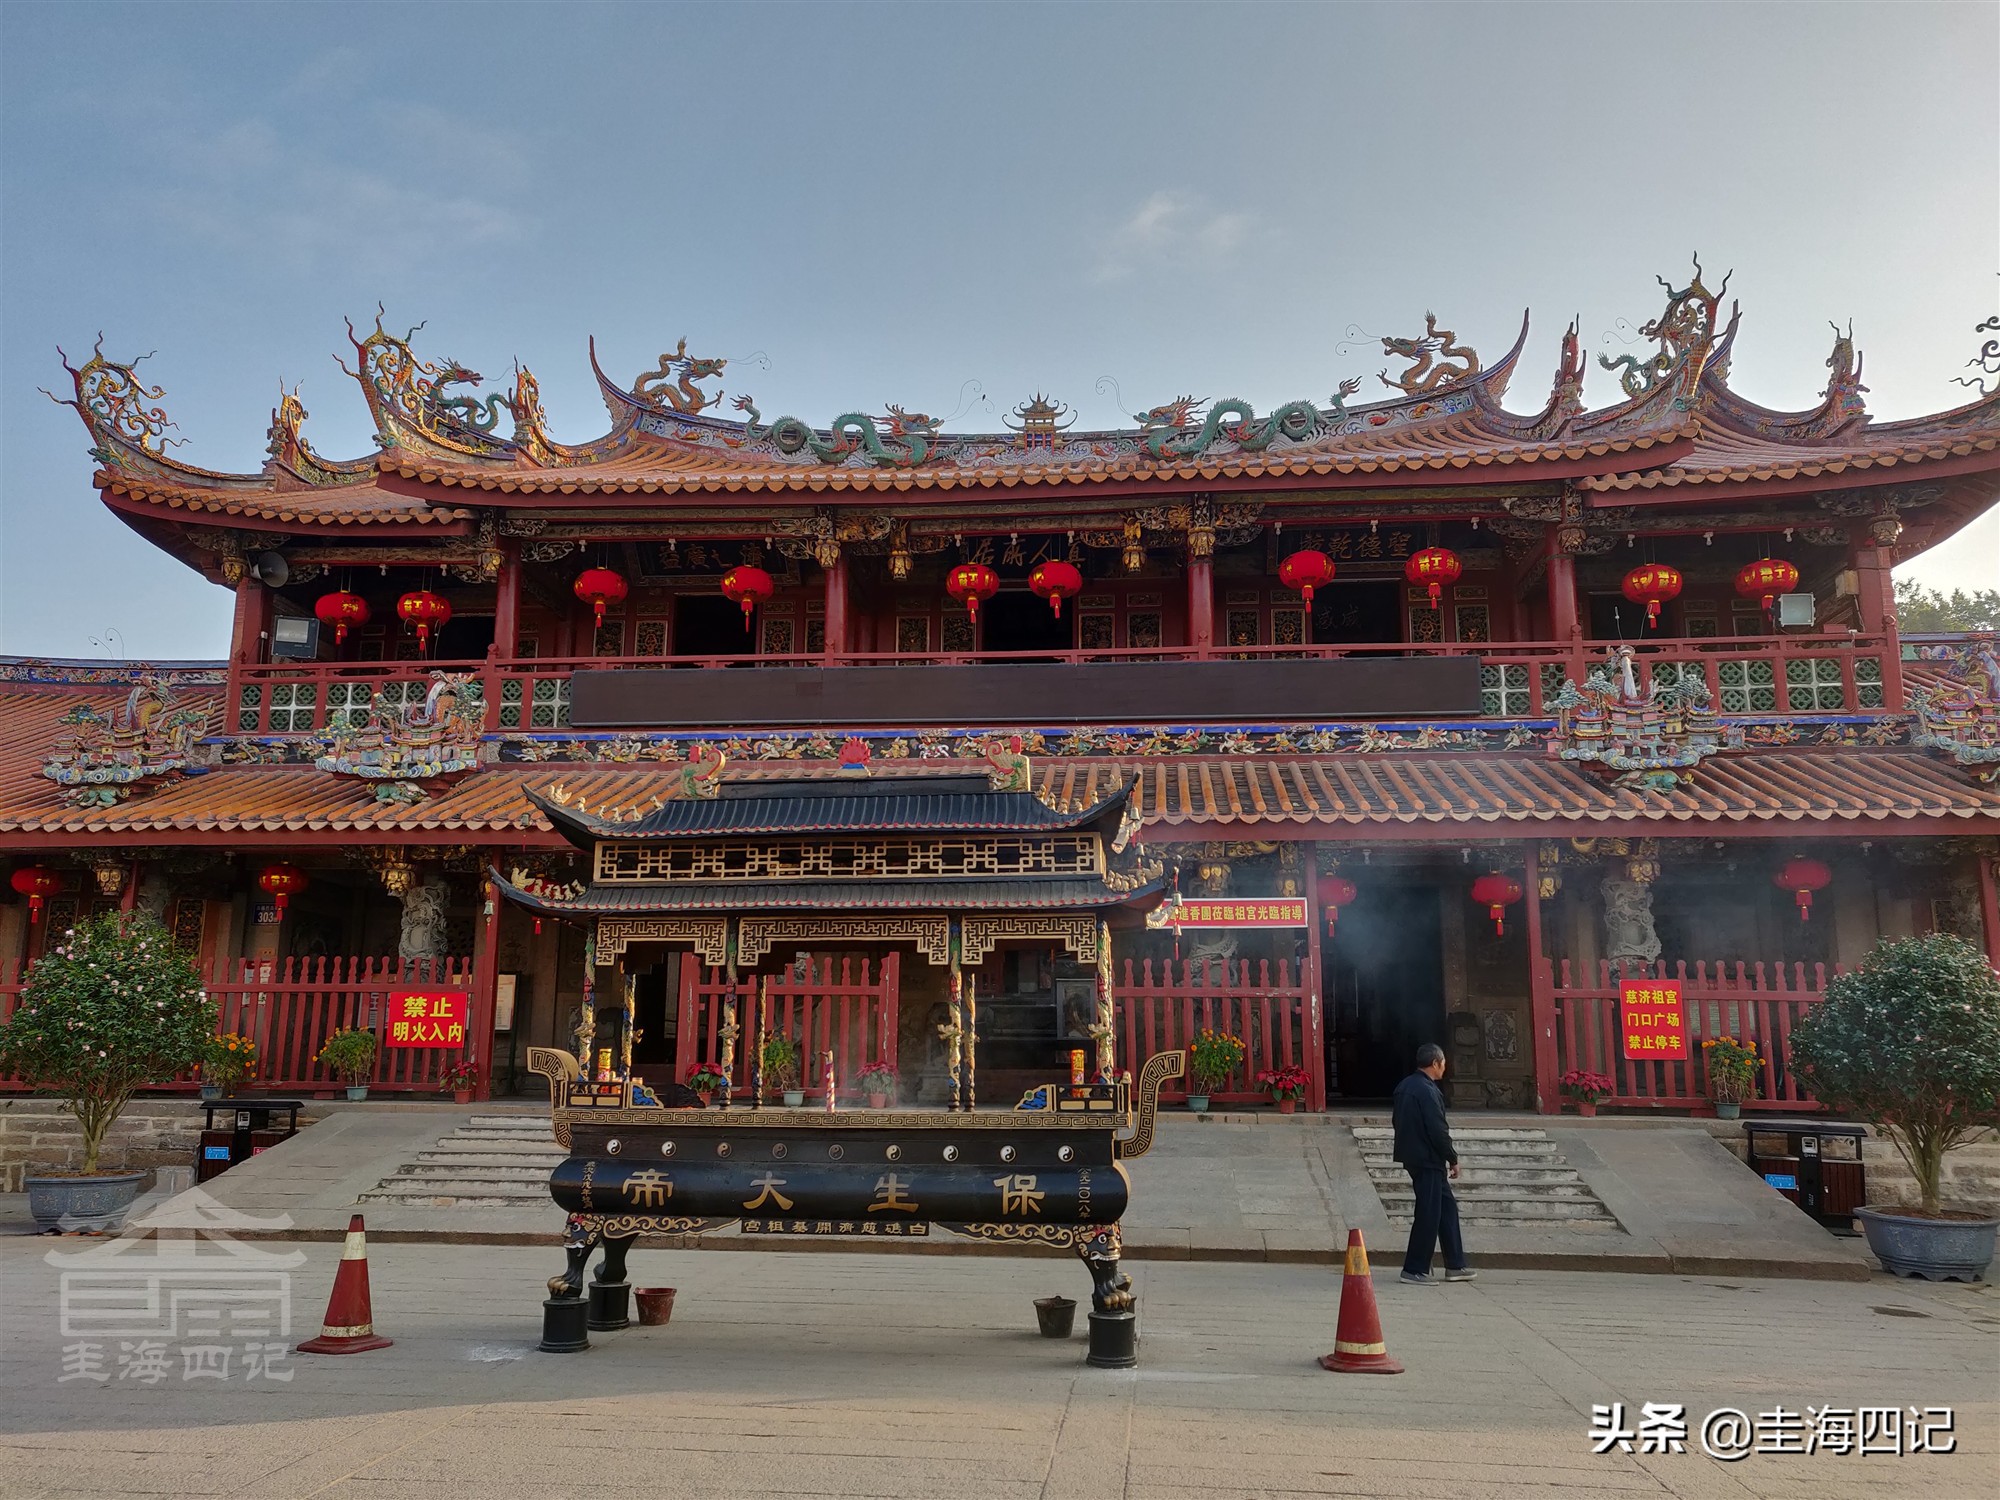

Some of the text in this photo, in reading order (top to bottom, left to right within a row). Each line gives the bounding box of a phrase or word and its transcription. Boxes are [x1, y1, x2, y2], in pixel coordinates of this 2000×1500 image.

[1625, 989, 1678, 1005] 慈济祖宫
[403, 996, 454, 1018] 禁止
[1627, 1012, 1680, 1027] 门口广场
[392, 1021, 463, 1043] 明火入内
[1628, 1035, 1681, 1050] 禁止停车
